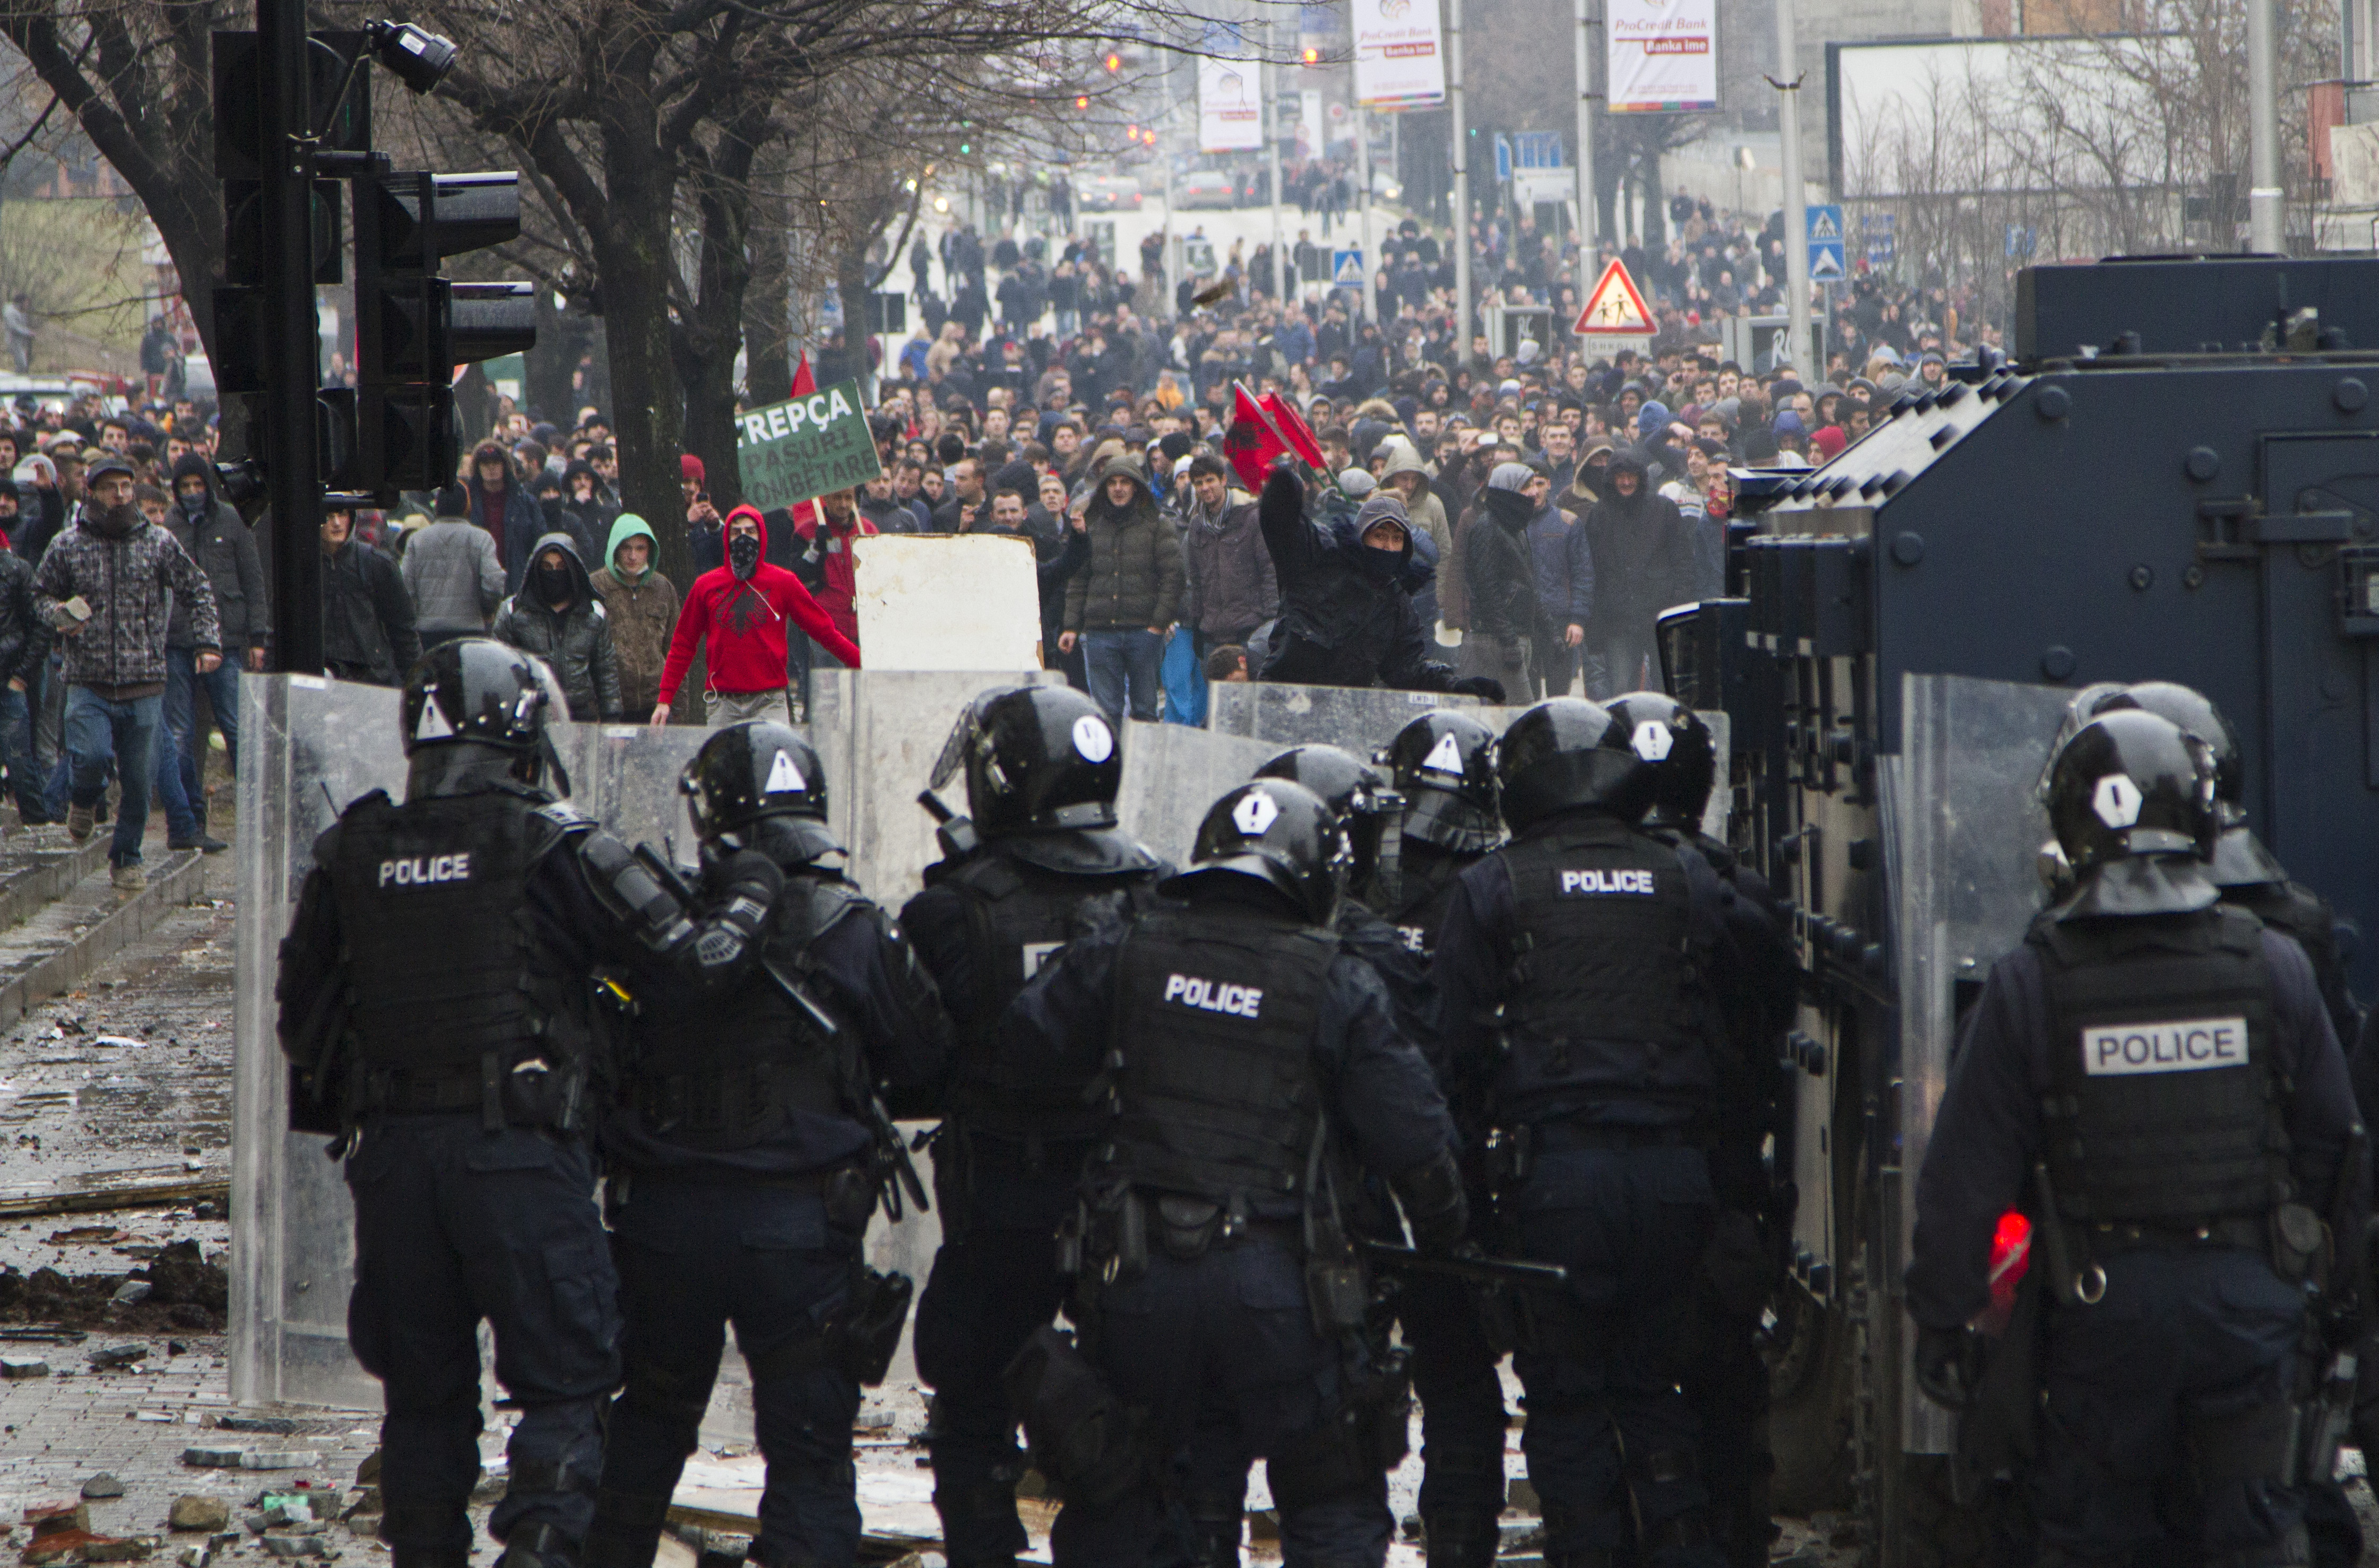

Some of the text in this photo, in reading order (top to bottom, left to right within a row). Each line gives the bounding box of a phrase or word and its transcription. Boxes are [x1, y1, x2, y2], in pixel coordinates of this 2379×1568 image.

[1615, 17, 1707, 31] ProCredit Bank
[745, 427, 853, 477] PASURI
[378, 853, 470, 888] POLICE
[1562, 869, 1654, 894] POLICE
[1165, 973, 1263, 1019] POLICE
[2098, 1029, 2236, 1067] POLICE
